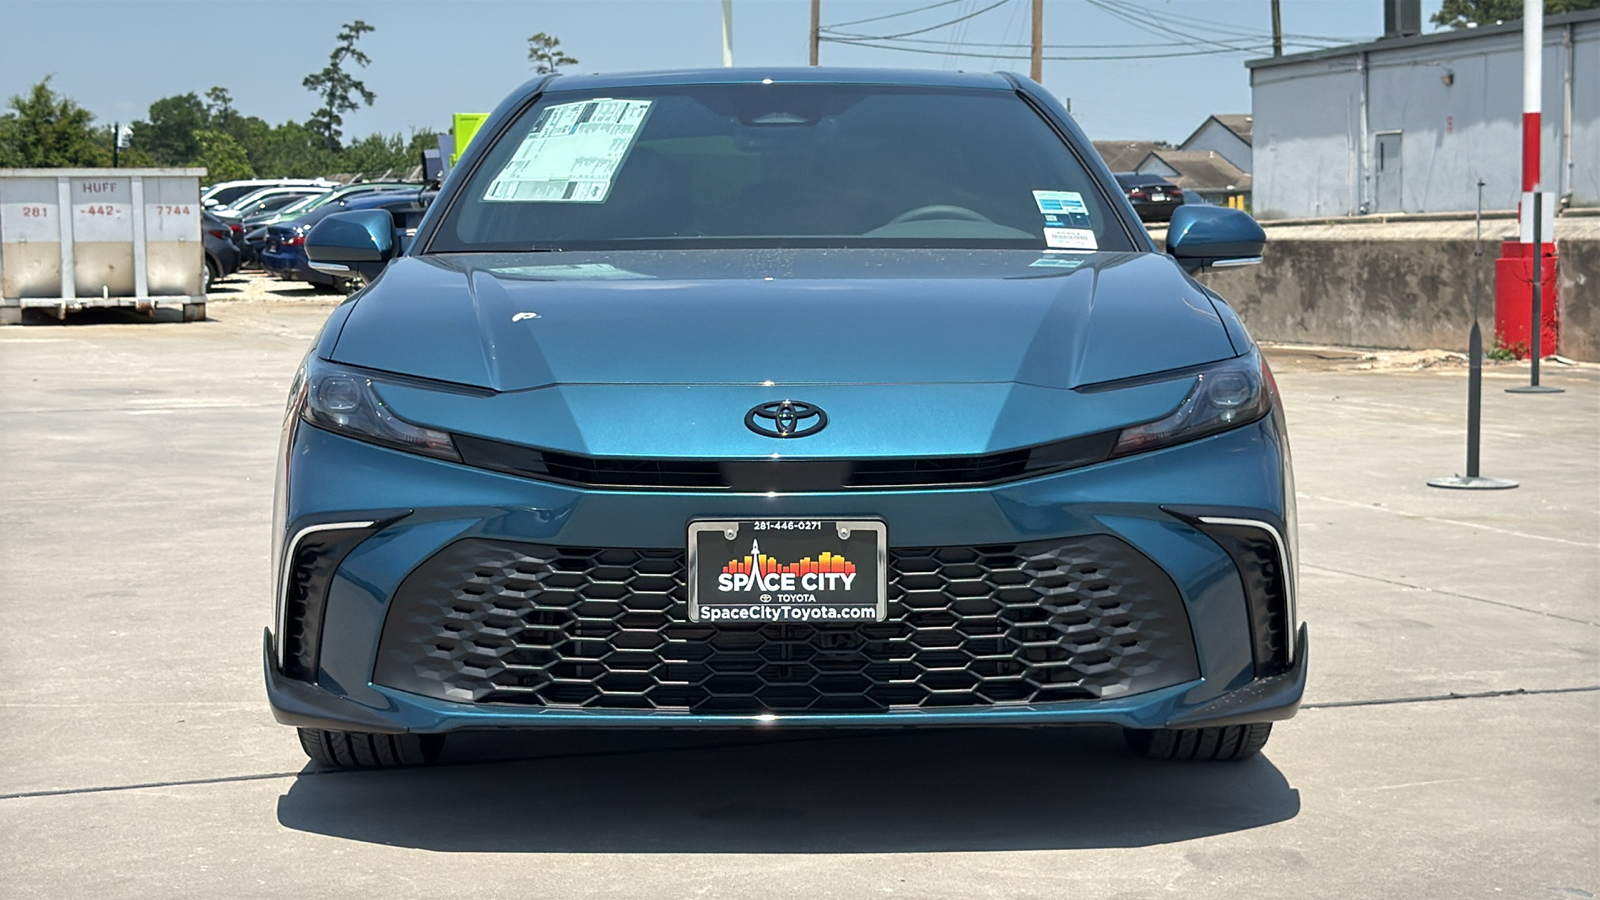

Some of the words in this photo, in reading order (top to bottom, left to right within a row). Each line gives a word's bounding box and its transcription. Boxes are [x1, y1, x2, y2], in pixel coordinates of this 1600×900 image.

[82, 182, 118, 193] HUFF
[23, 207, 48, 217] 281
[156, 205, 191, 216] 7744
[753, 521, 822, 530] 281-446-0271
[717, 572, 796, 592] SPACE
[801, 572, 857, 591] CITY
[777, 594, 816, 603] TOYOTA
[700, 606, 876, 621] SpaceCityToyota.com
